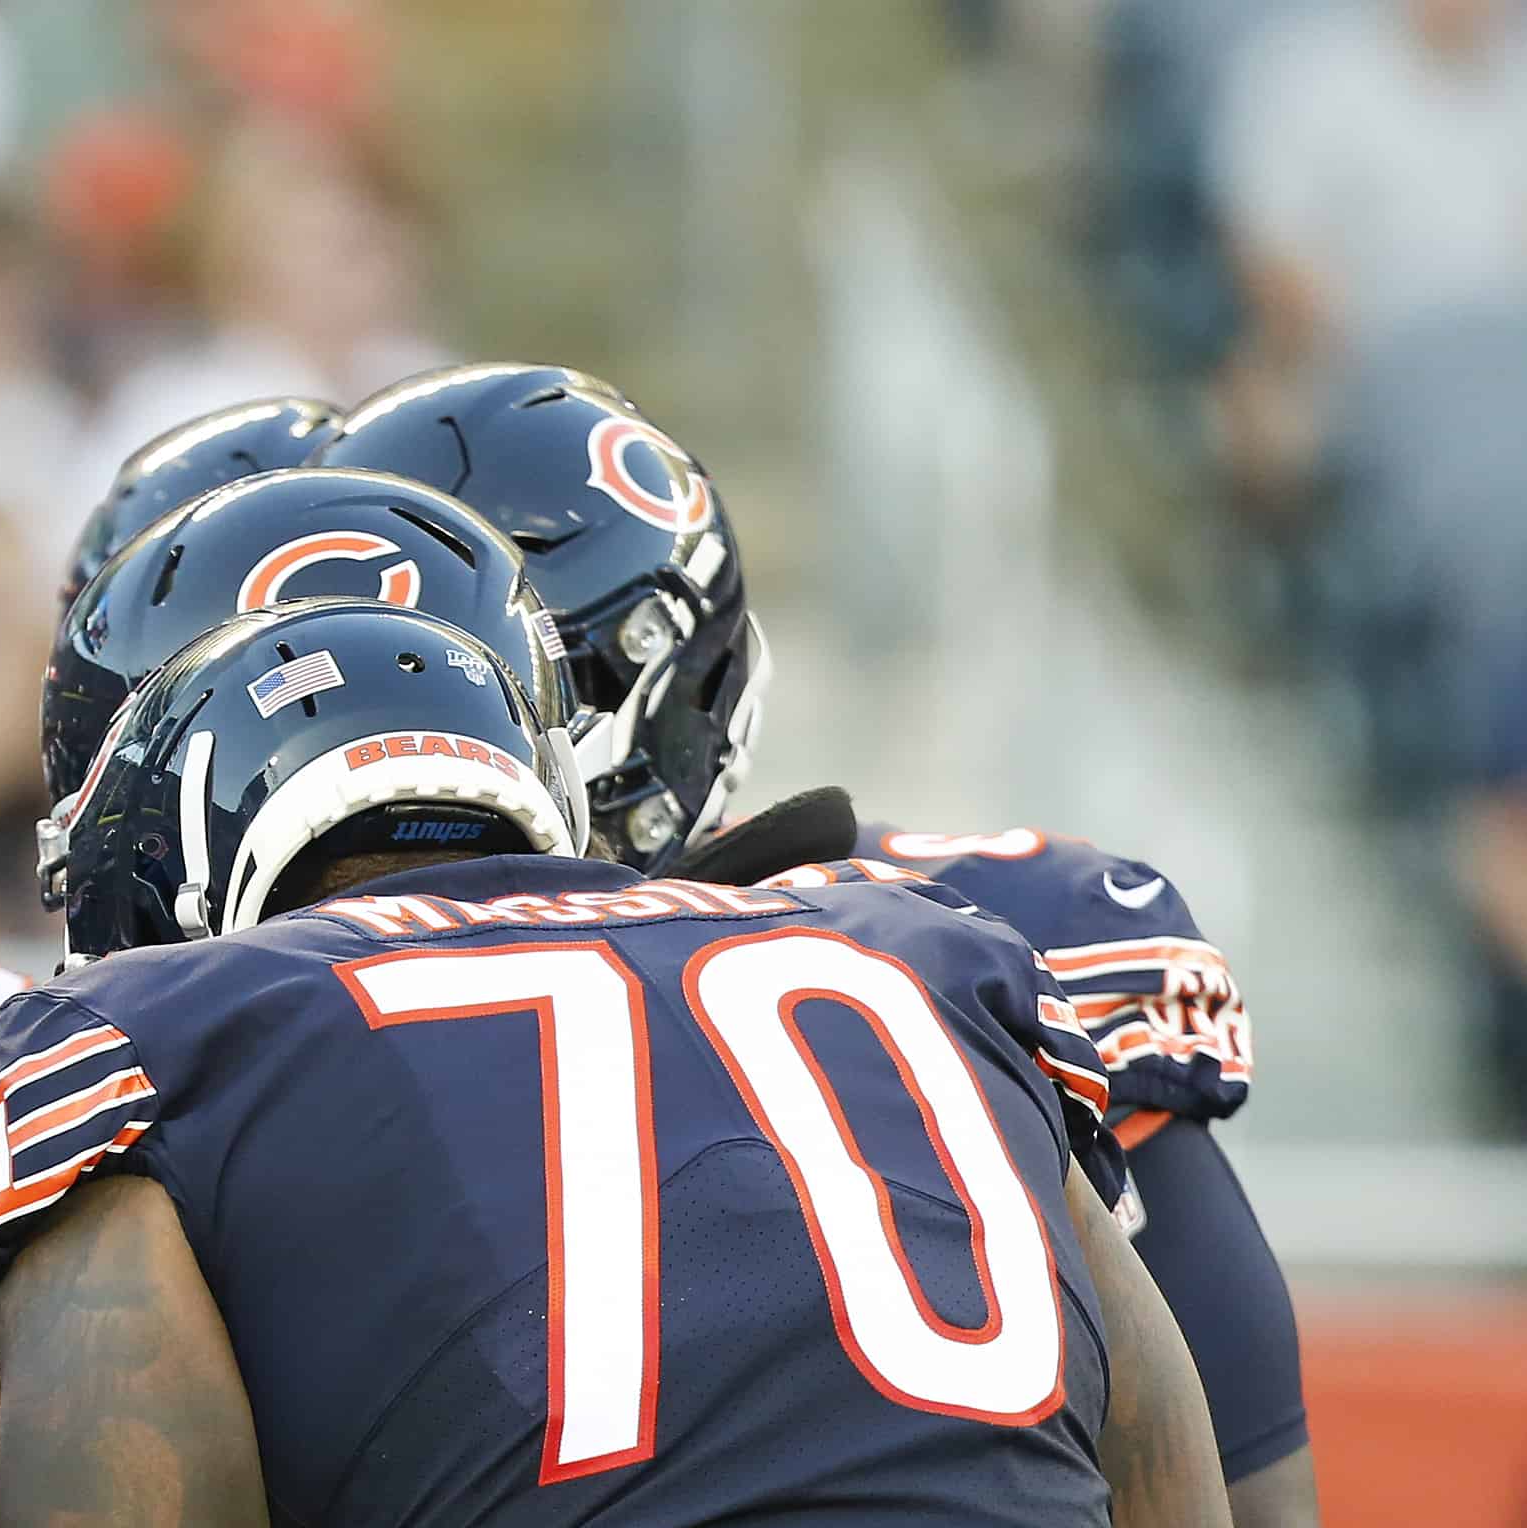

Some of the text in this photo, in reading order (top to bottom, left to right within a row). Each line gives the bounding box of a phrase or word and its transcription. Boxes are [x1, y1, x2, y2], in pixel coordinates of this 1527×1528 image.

[344, 735, 521, 781] BEARS
[321, 878, 798, 936] MASSIE
[332, 926, 1066, 1486] 70
